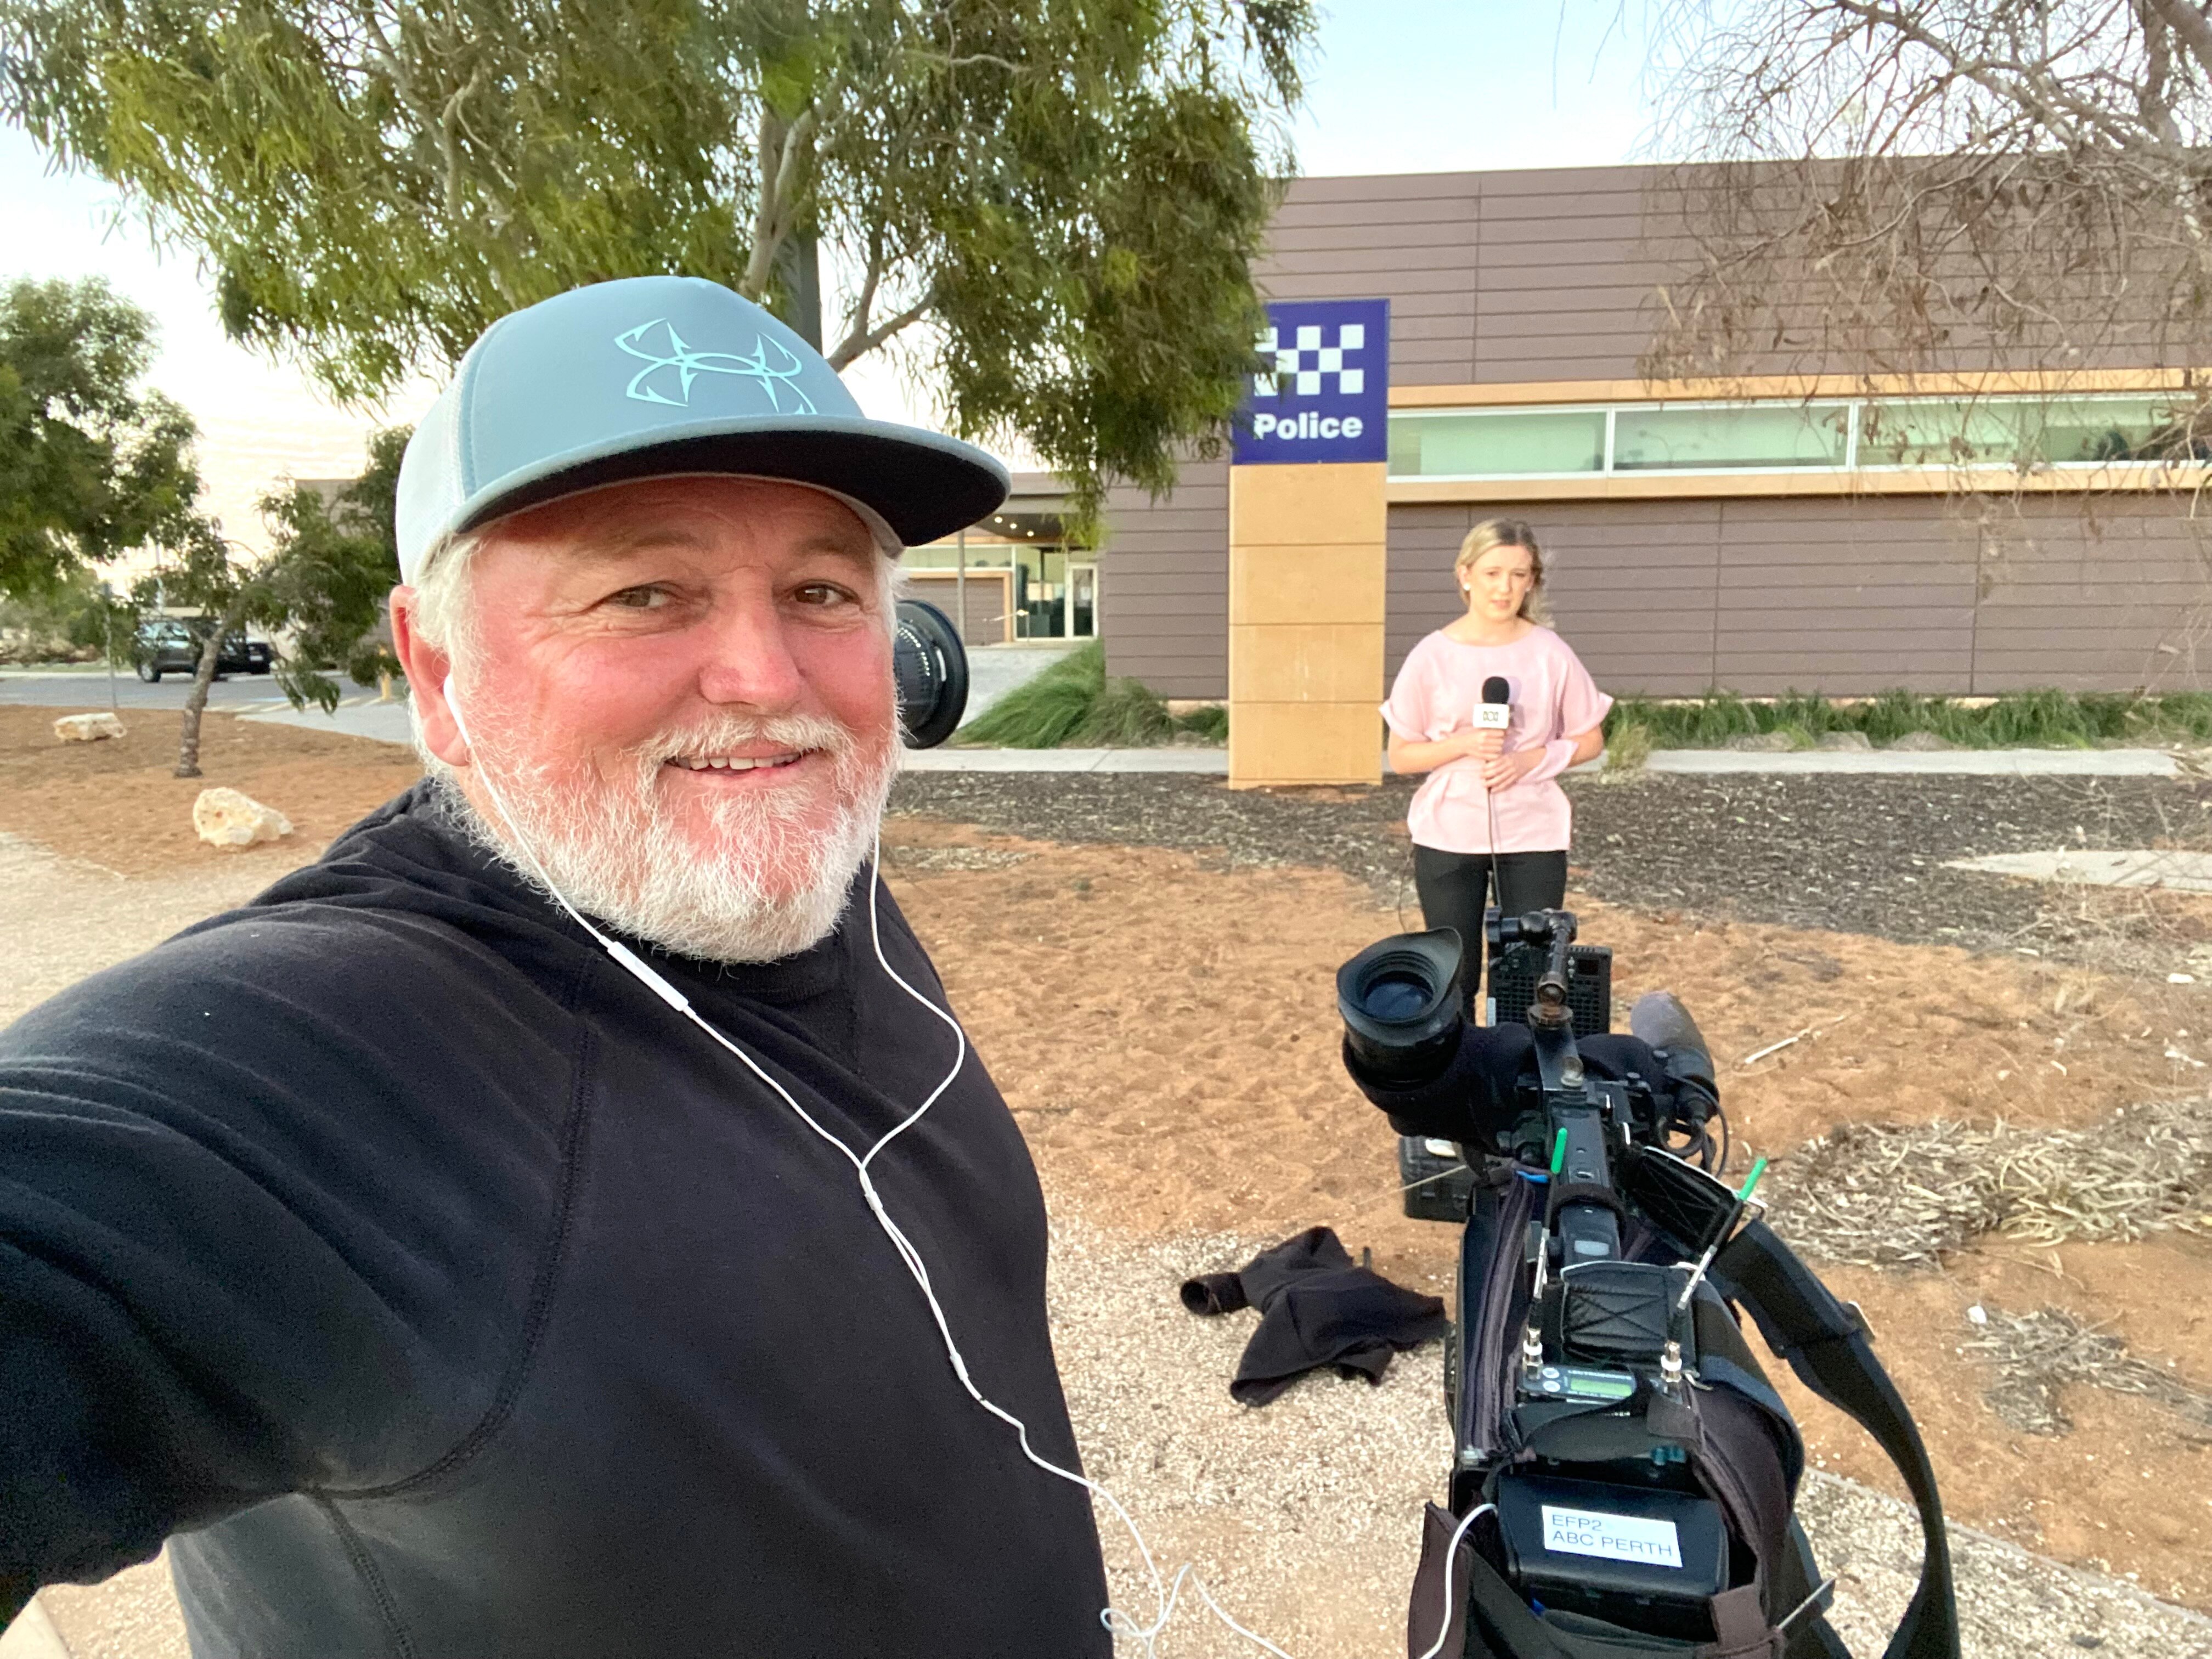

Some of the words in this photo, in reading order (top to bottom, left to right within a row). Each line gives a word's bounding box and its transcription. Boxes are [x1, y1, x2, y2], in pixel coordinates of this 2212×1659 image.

[1254, 411, 1363, 440] Police
[1552, 1514, 1602, 1531] EFP2
[1553, 1530, 1594, 1546] ABC
[1601, 1537, 1672, 1556] PERTH
